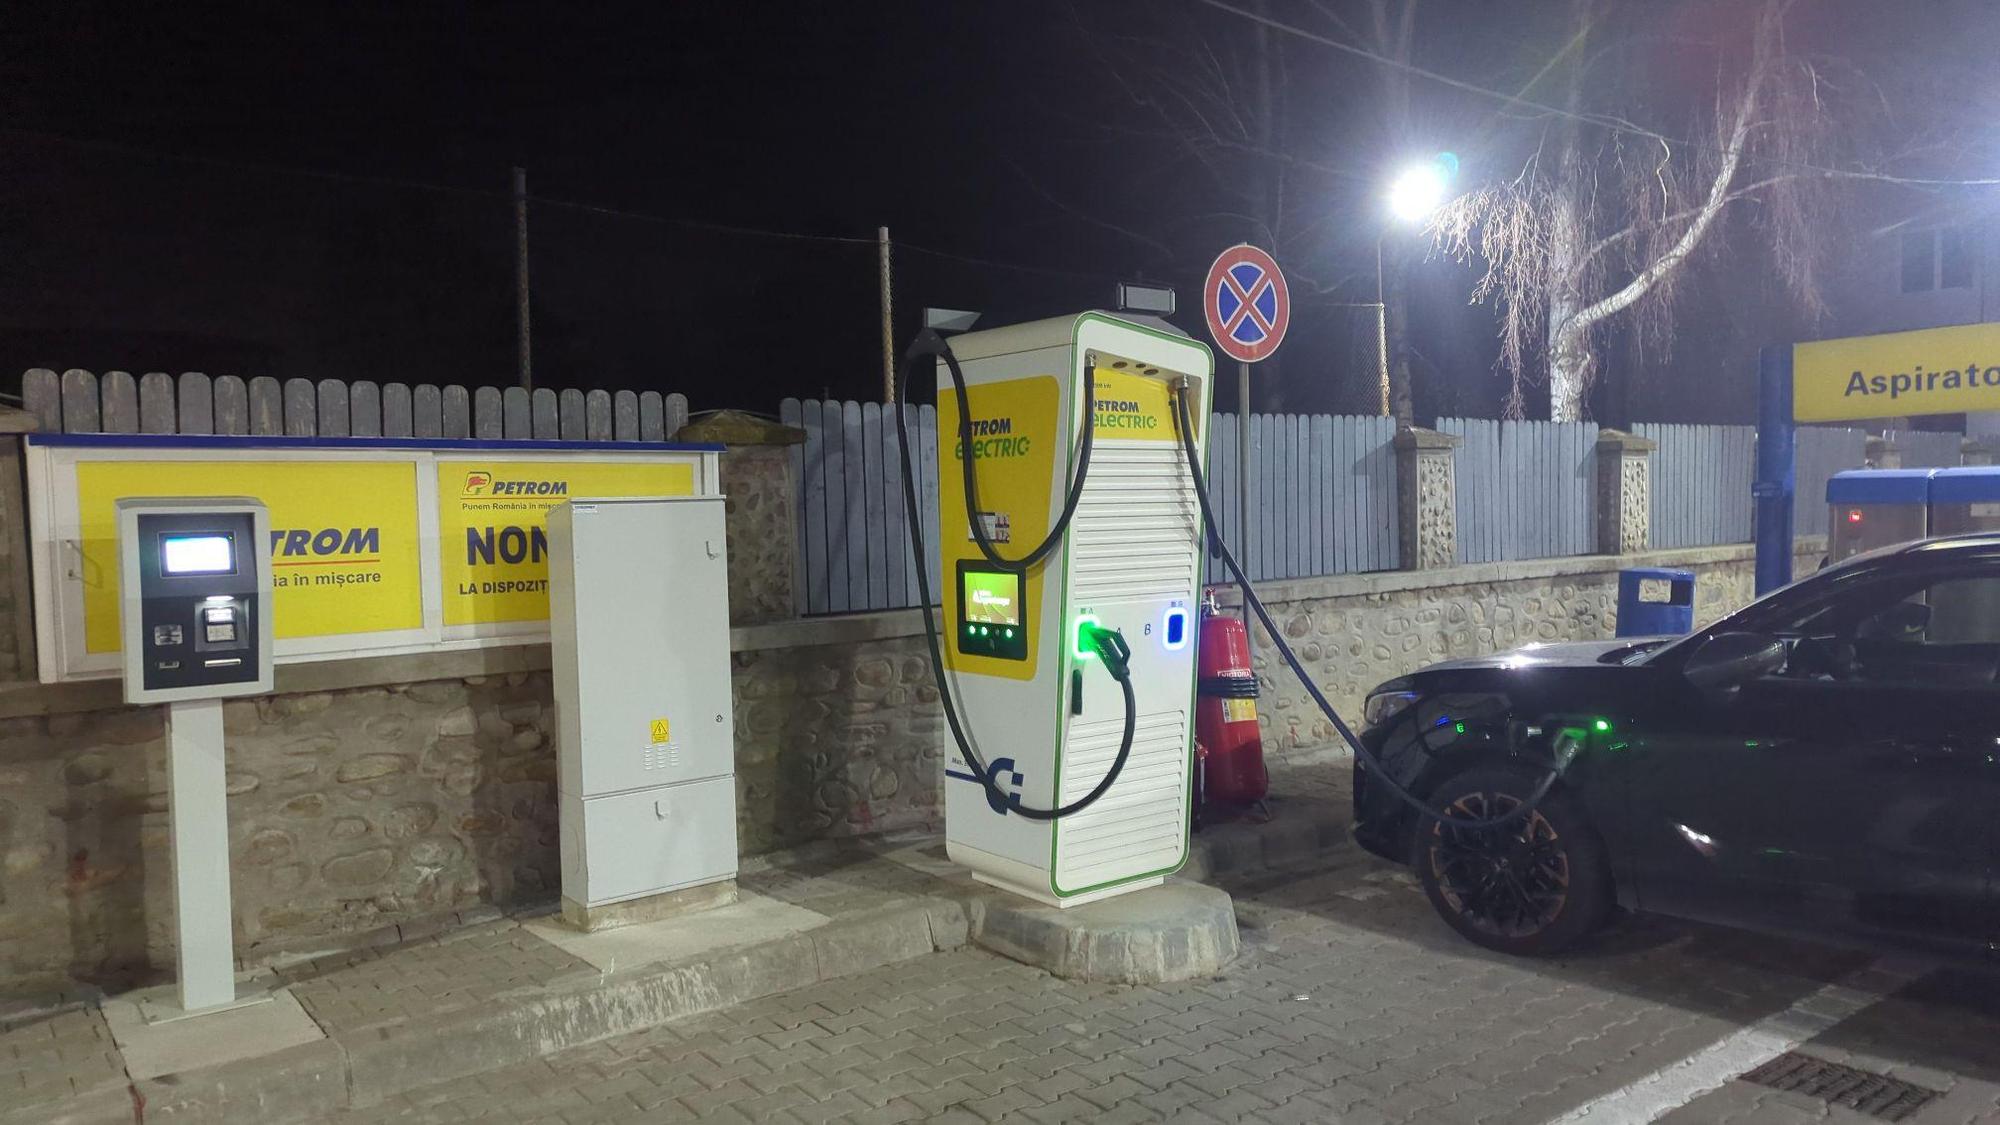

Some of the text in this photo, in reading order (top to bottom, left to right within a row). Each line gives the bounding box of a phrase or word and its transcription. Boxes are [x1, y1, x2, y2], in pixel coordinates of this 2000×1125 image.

[1843, 363, 2000, 399] Aspirato
[957, 418, 1011, 438] TROM
[492, 481, 568, 495] PETROM
[466, 526, 548, 565] NON
[293, 573, 309, 586] în
[315, 571, 381, 588] mișcare
[459, 583, 478, 595] LA
[1144, 623, 1151, 636] B
